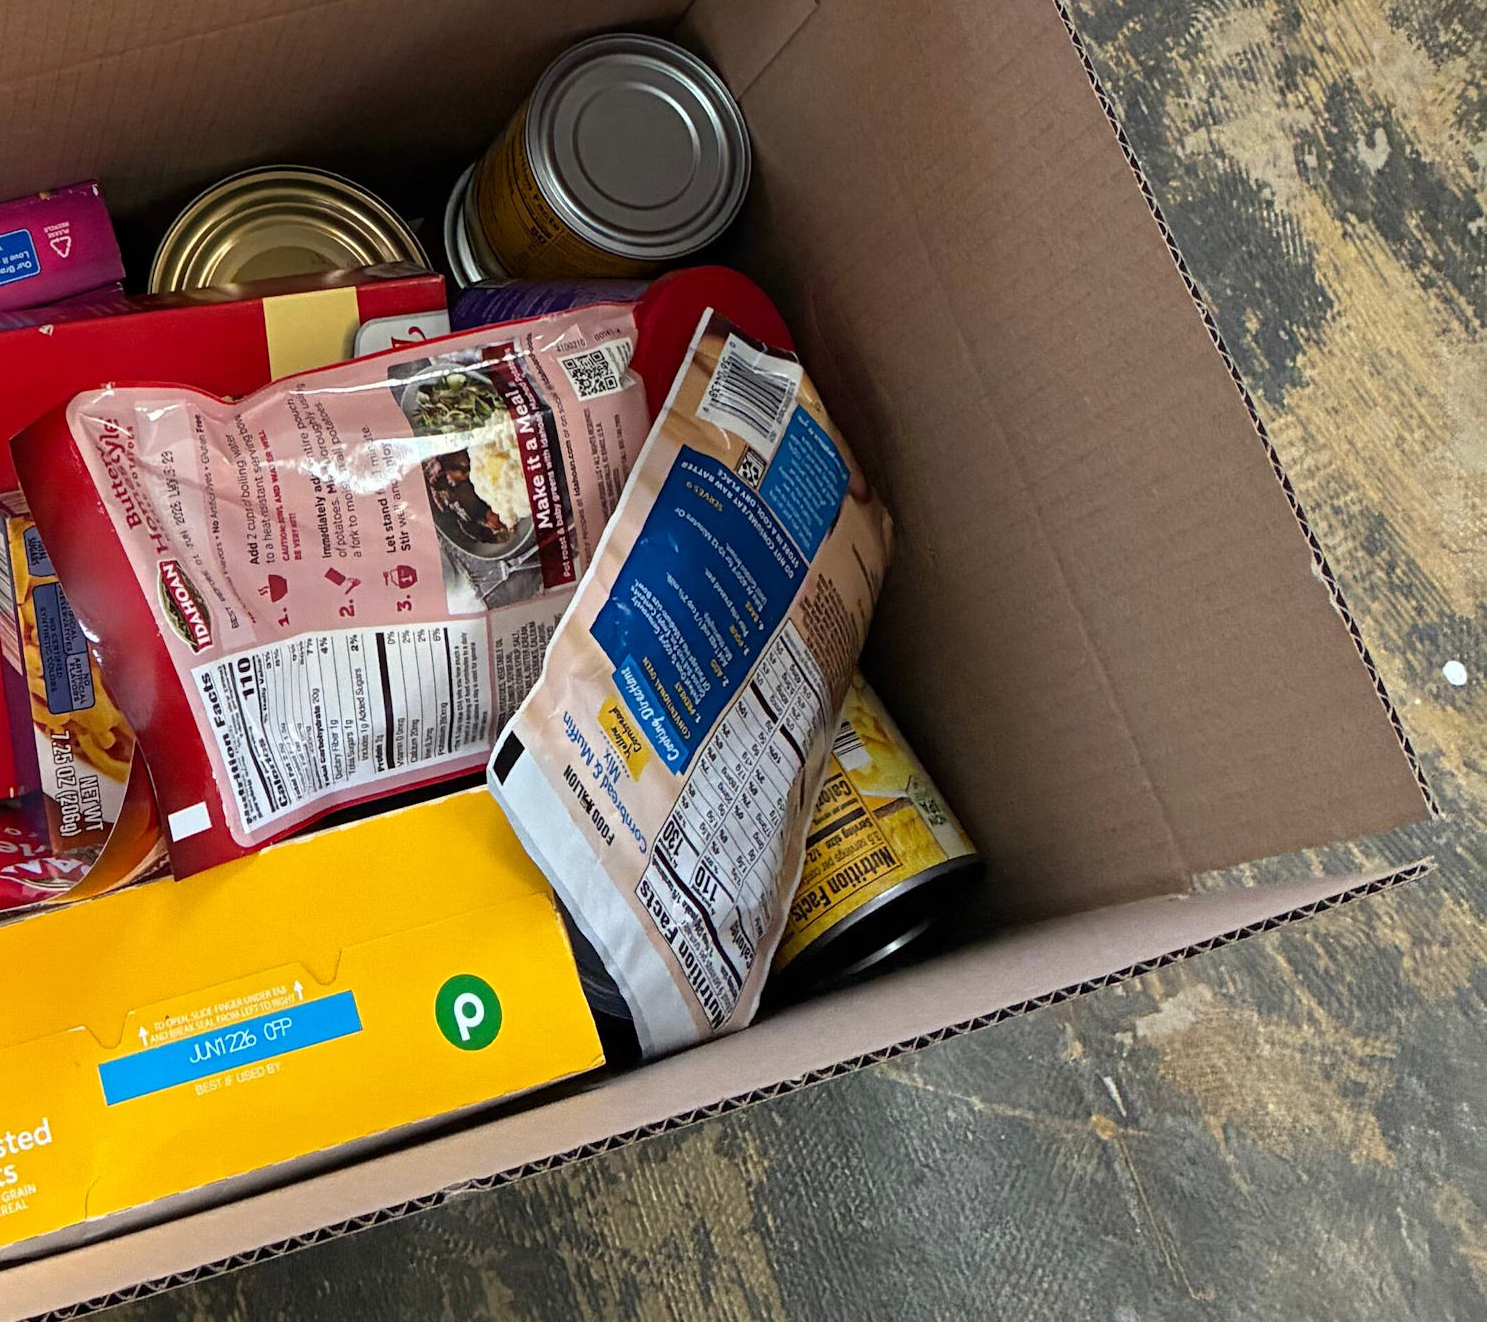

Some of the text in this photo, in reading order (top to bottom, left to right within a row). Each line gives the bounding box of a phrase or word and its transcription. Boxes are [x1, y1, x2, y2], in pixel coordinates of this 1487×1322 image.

[15, 259, 32, 271] Our
[224, 432, 241, 458] water
[506, 388, 554, 529] Make it a Meal
[234, 459, 251, 498] boiling
[246, 532, 256, 540] 2
[377, 498, 396, 553] Let stand
[247, 541, 260, 565] Add
[159, 564, 211, 650] IDAHOAN
[275, 606, 289, 626] 1.
[338, 598, 355, 618] 2.
[395, 594, 412, 611] 3.
[197, 671, 225, 727] Facts
[236, 656, 256, 700] 110
[617, 665, 655, 720] Directions
[640, 656, 693, 740] CONVENTIONAL OVEN
[646, 713, 685, 762] Cooking
[49, 729, 83, 837] 7.25 OZ (206g)
[216, 733, 252, 825] Nutrition
[255, 736, 289, 808] Calories
[556, 710, 651, 855] Cornbread & Muffin
[599, 750, 625, 783] Mix
[78, 774, 104, 832] NET WT
[560, 763, 617, 846] FOOD LION
[807, 813, 873, 862] Serving size 1/2
[786, 843, 897, 925] Nutrition Facts
[634, 879, 727, 1027] Nutrition Facts
[148, 992, 295, 1043] AND BREAK SEAL FROM LEFT TO RIGHT
[152, 1020, 165, 1031] TO
[189, 1006, 212, 1020] SLIDE
[212, 997, 241, 1014] FINGER
[241, 989, 271, 1005] UNDER
[271, 985, 287, 997] TAB
[0, 1182, 37, 1202] GRAIN
